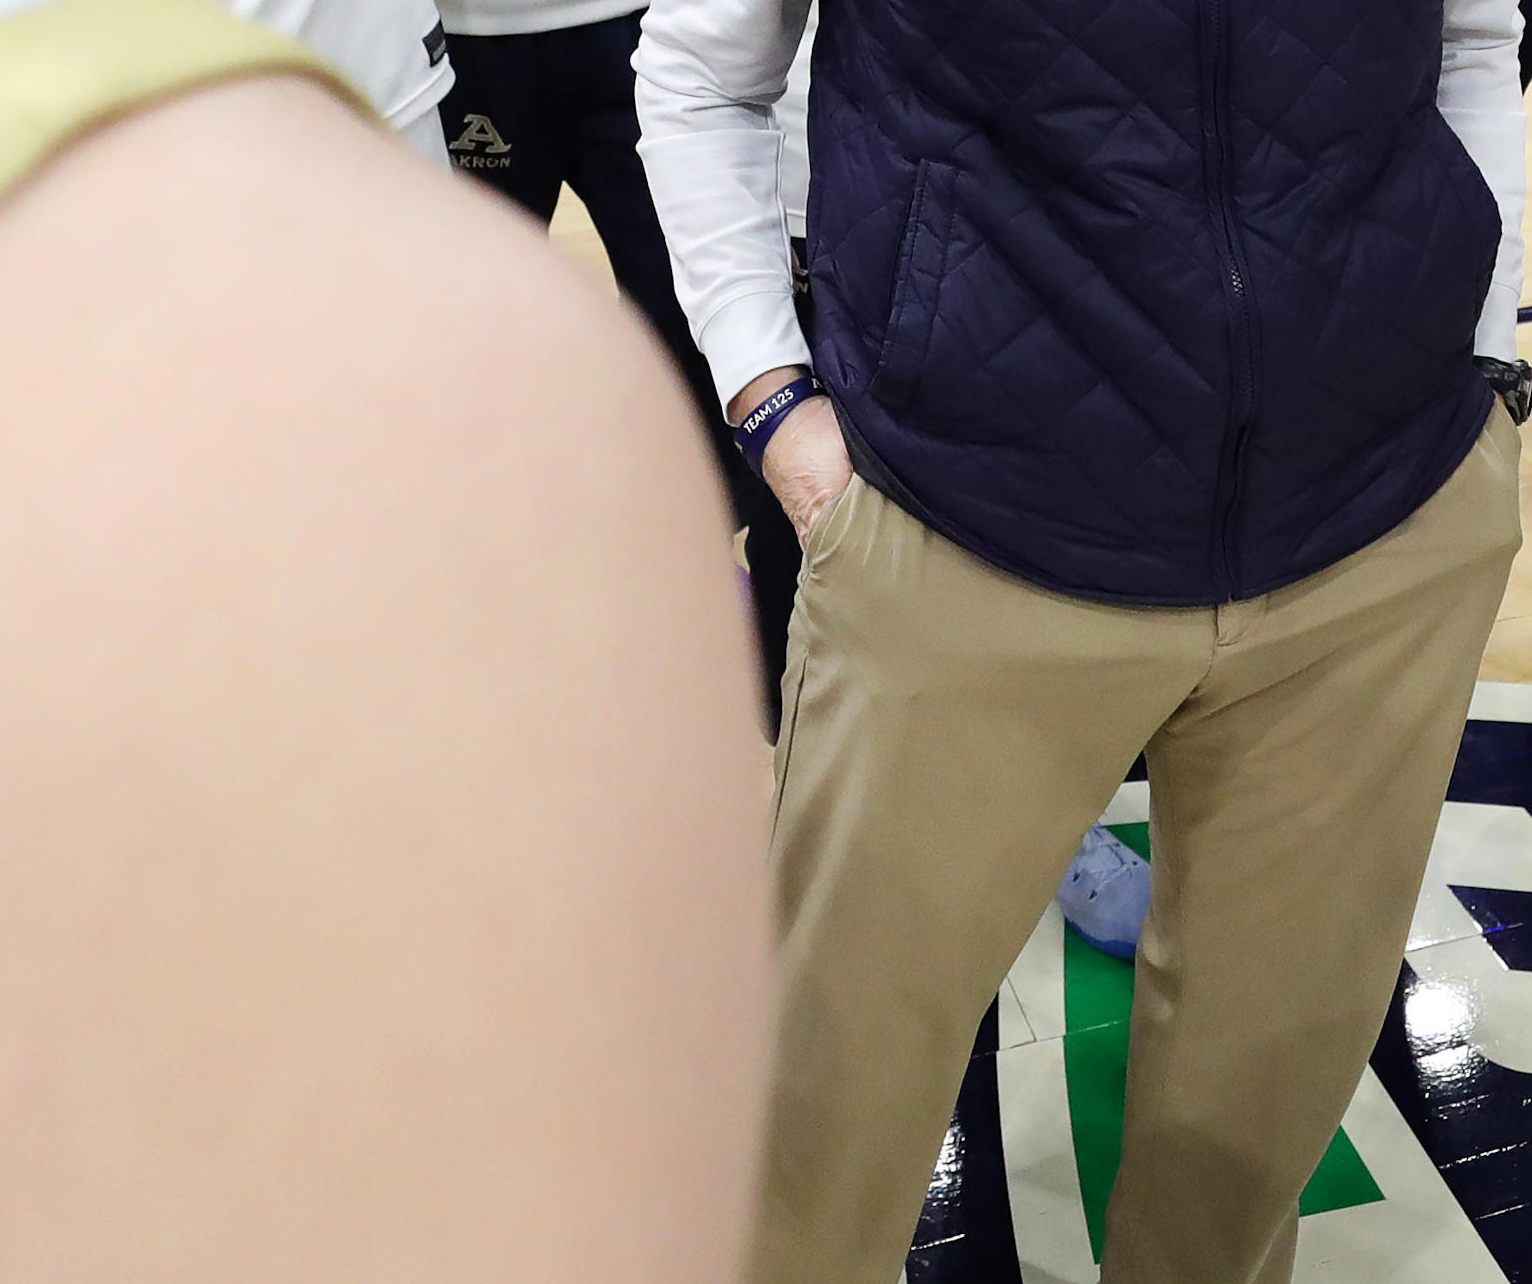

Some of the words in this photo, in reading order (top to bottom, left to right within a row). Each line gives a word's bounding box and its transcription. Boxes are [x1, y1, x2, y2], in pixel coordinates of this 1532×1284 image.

[449, 113, 512, 154] A
[743, 403, 773, 434] TEAM
[771, 388, 794, 410] 125
